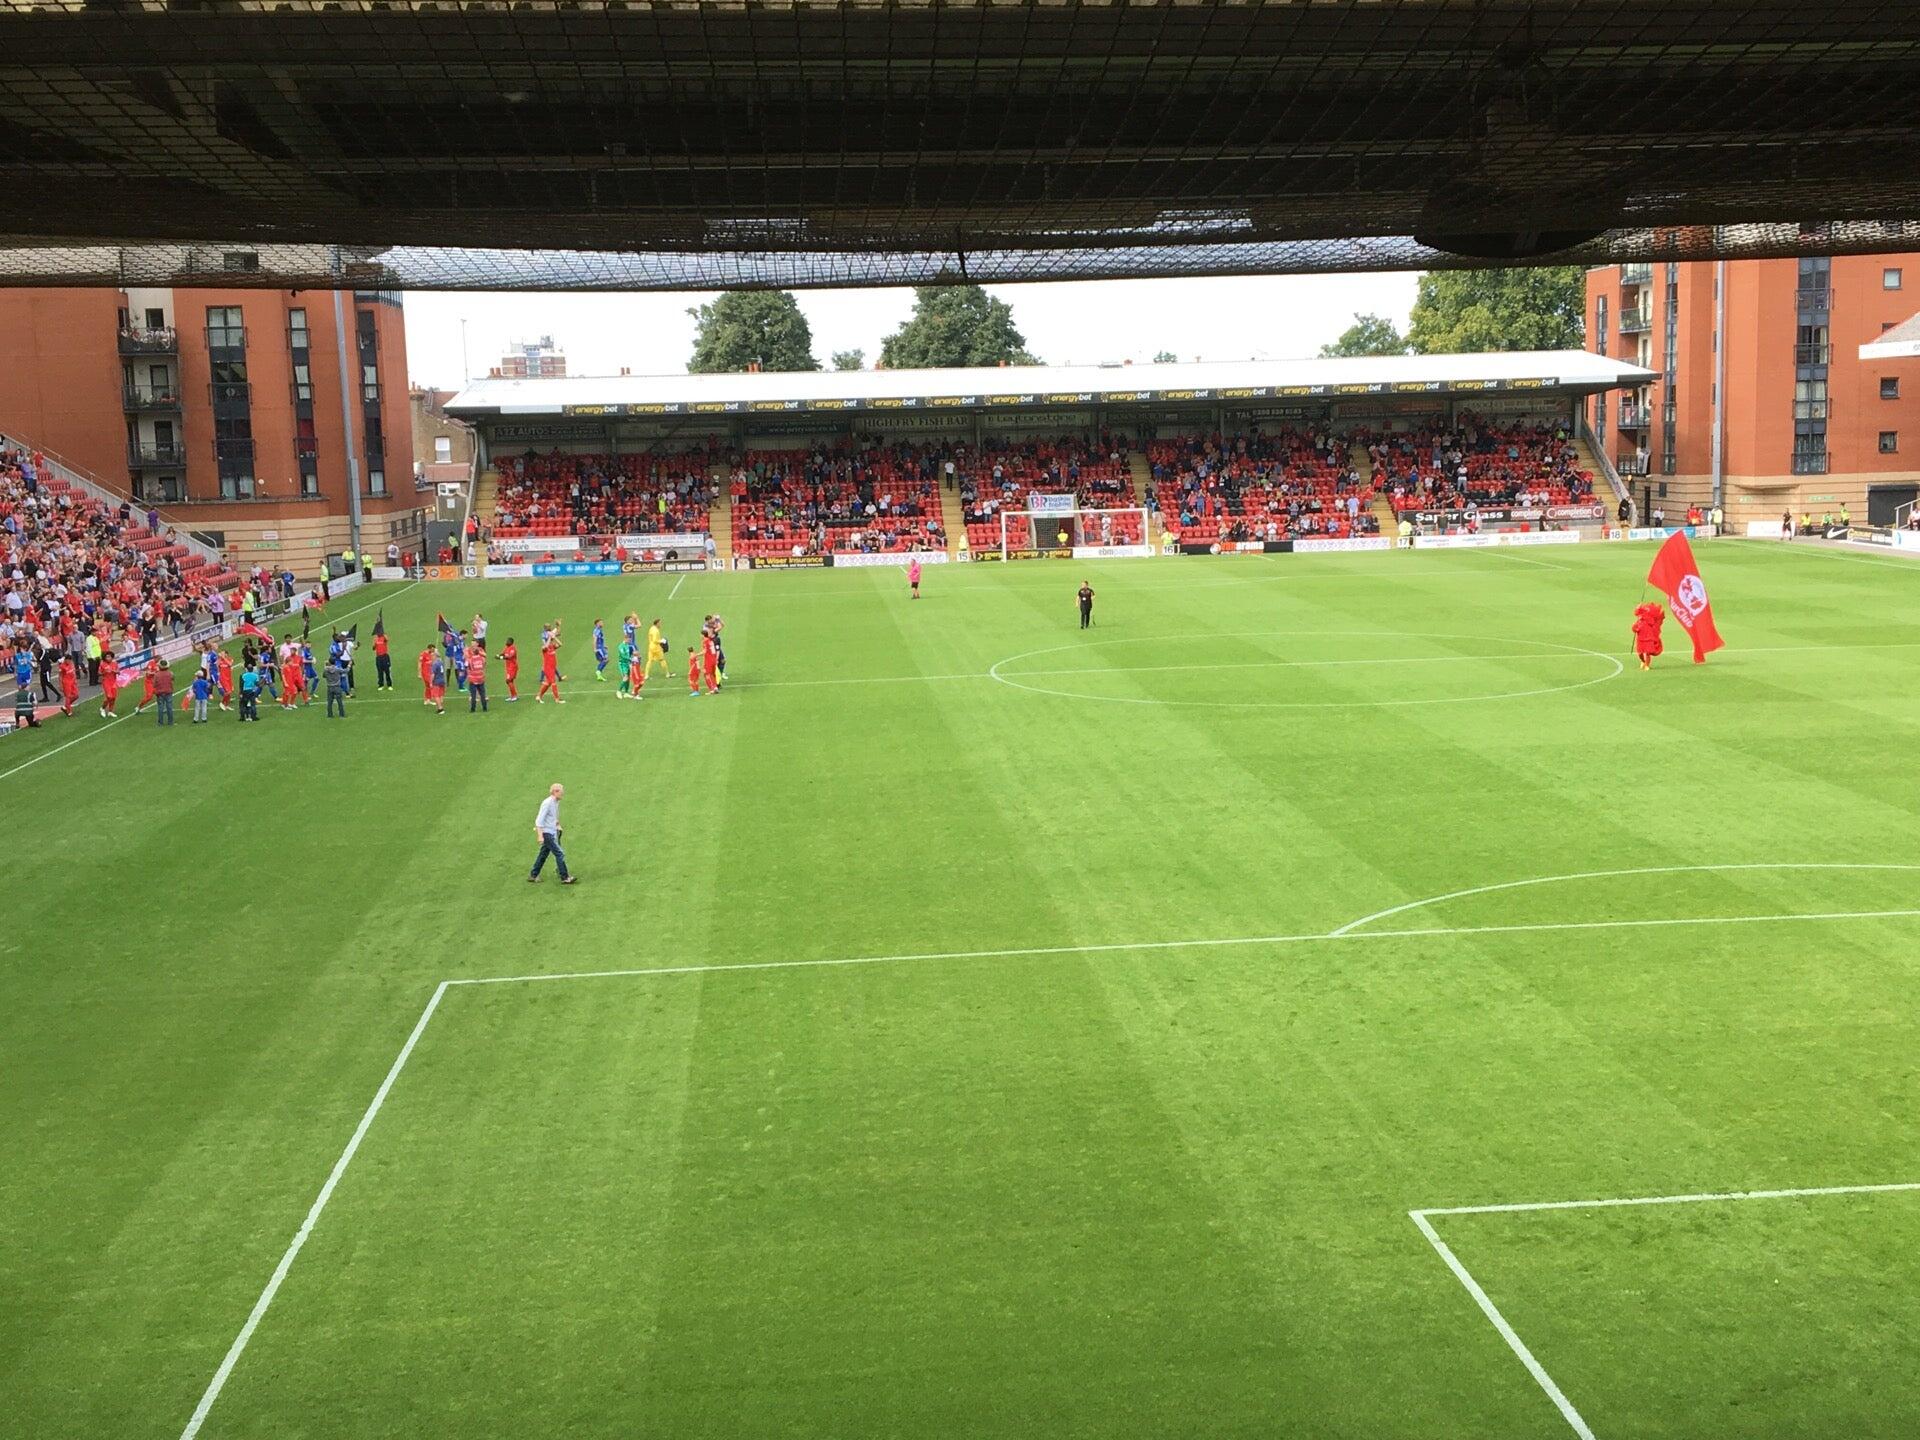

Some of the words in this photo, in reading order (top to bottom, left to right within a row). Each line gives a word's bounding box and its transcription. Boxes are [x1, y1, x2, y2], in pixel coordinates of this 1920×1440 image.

[1399, 382, 1440, 391] energybet
[1456, 380, 1497, 389] energybet
[1515, 379, 1555, 387] energybet
[1226, 388, 1266, 397] energybet
[1283, 386, 1324, 395] energybet
[1341, 384, 1382, 393] energybet
[1051, 393, 1092, 402] energybet
[1110, 391, 1151, 400] energybet
[1168, 390, 1208, 399] energybet
[875, 399, 916, 407] energybet
[934, 397, 975, 405] energybet
[993, 395, 1034, 404] energybet
[636, 404, 679, 413] energybet
[697, 403, 739, 412] energybet
[756, 402, 799, 410] energybet
[815, 400, 858, 409] energybet
[575, 405, 618, 415] energybet
[865, 418, 893, 428] HIGH
[919, 417, 944, 426] FISH
[947, 416, 968, 425] BAR
[1031, 496, 1047, 508] BR
[1610, 530, 1619, 538] 18
[1399, 537, 1408, 546] 17
[1163, 546, 1173, 554] 16
[958, 552, 968, 560] 15
[465, 567, 476, 576] 13
